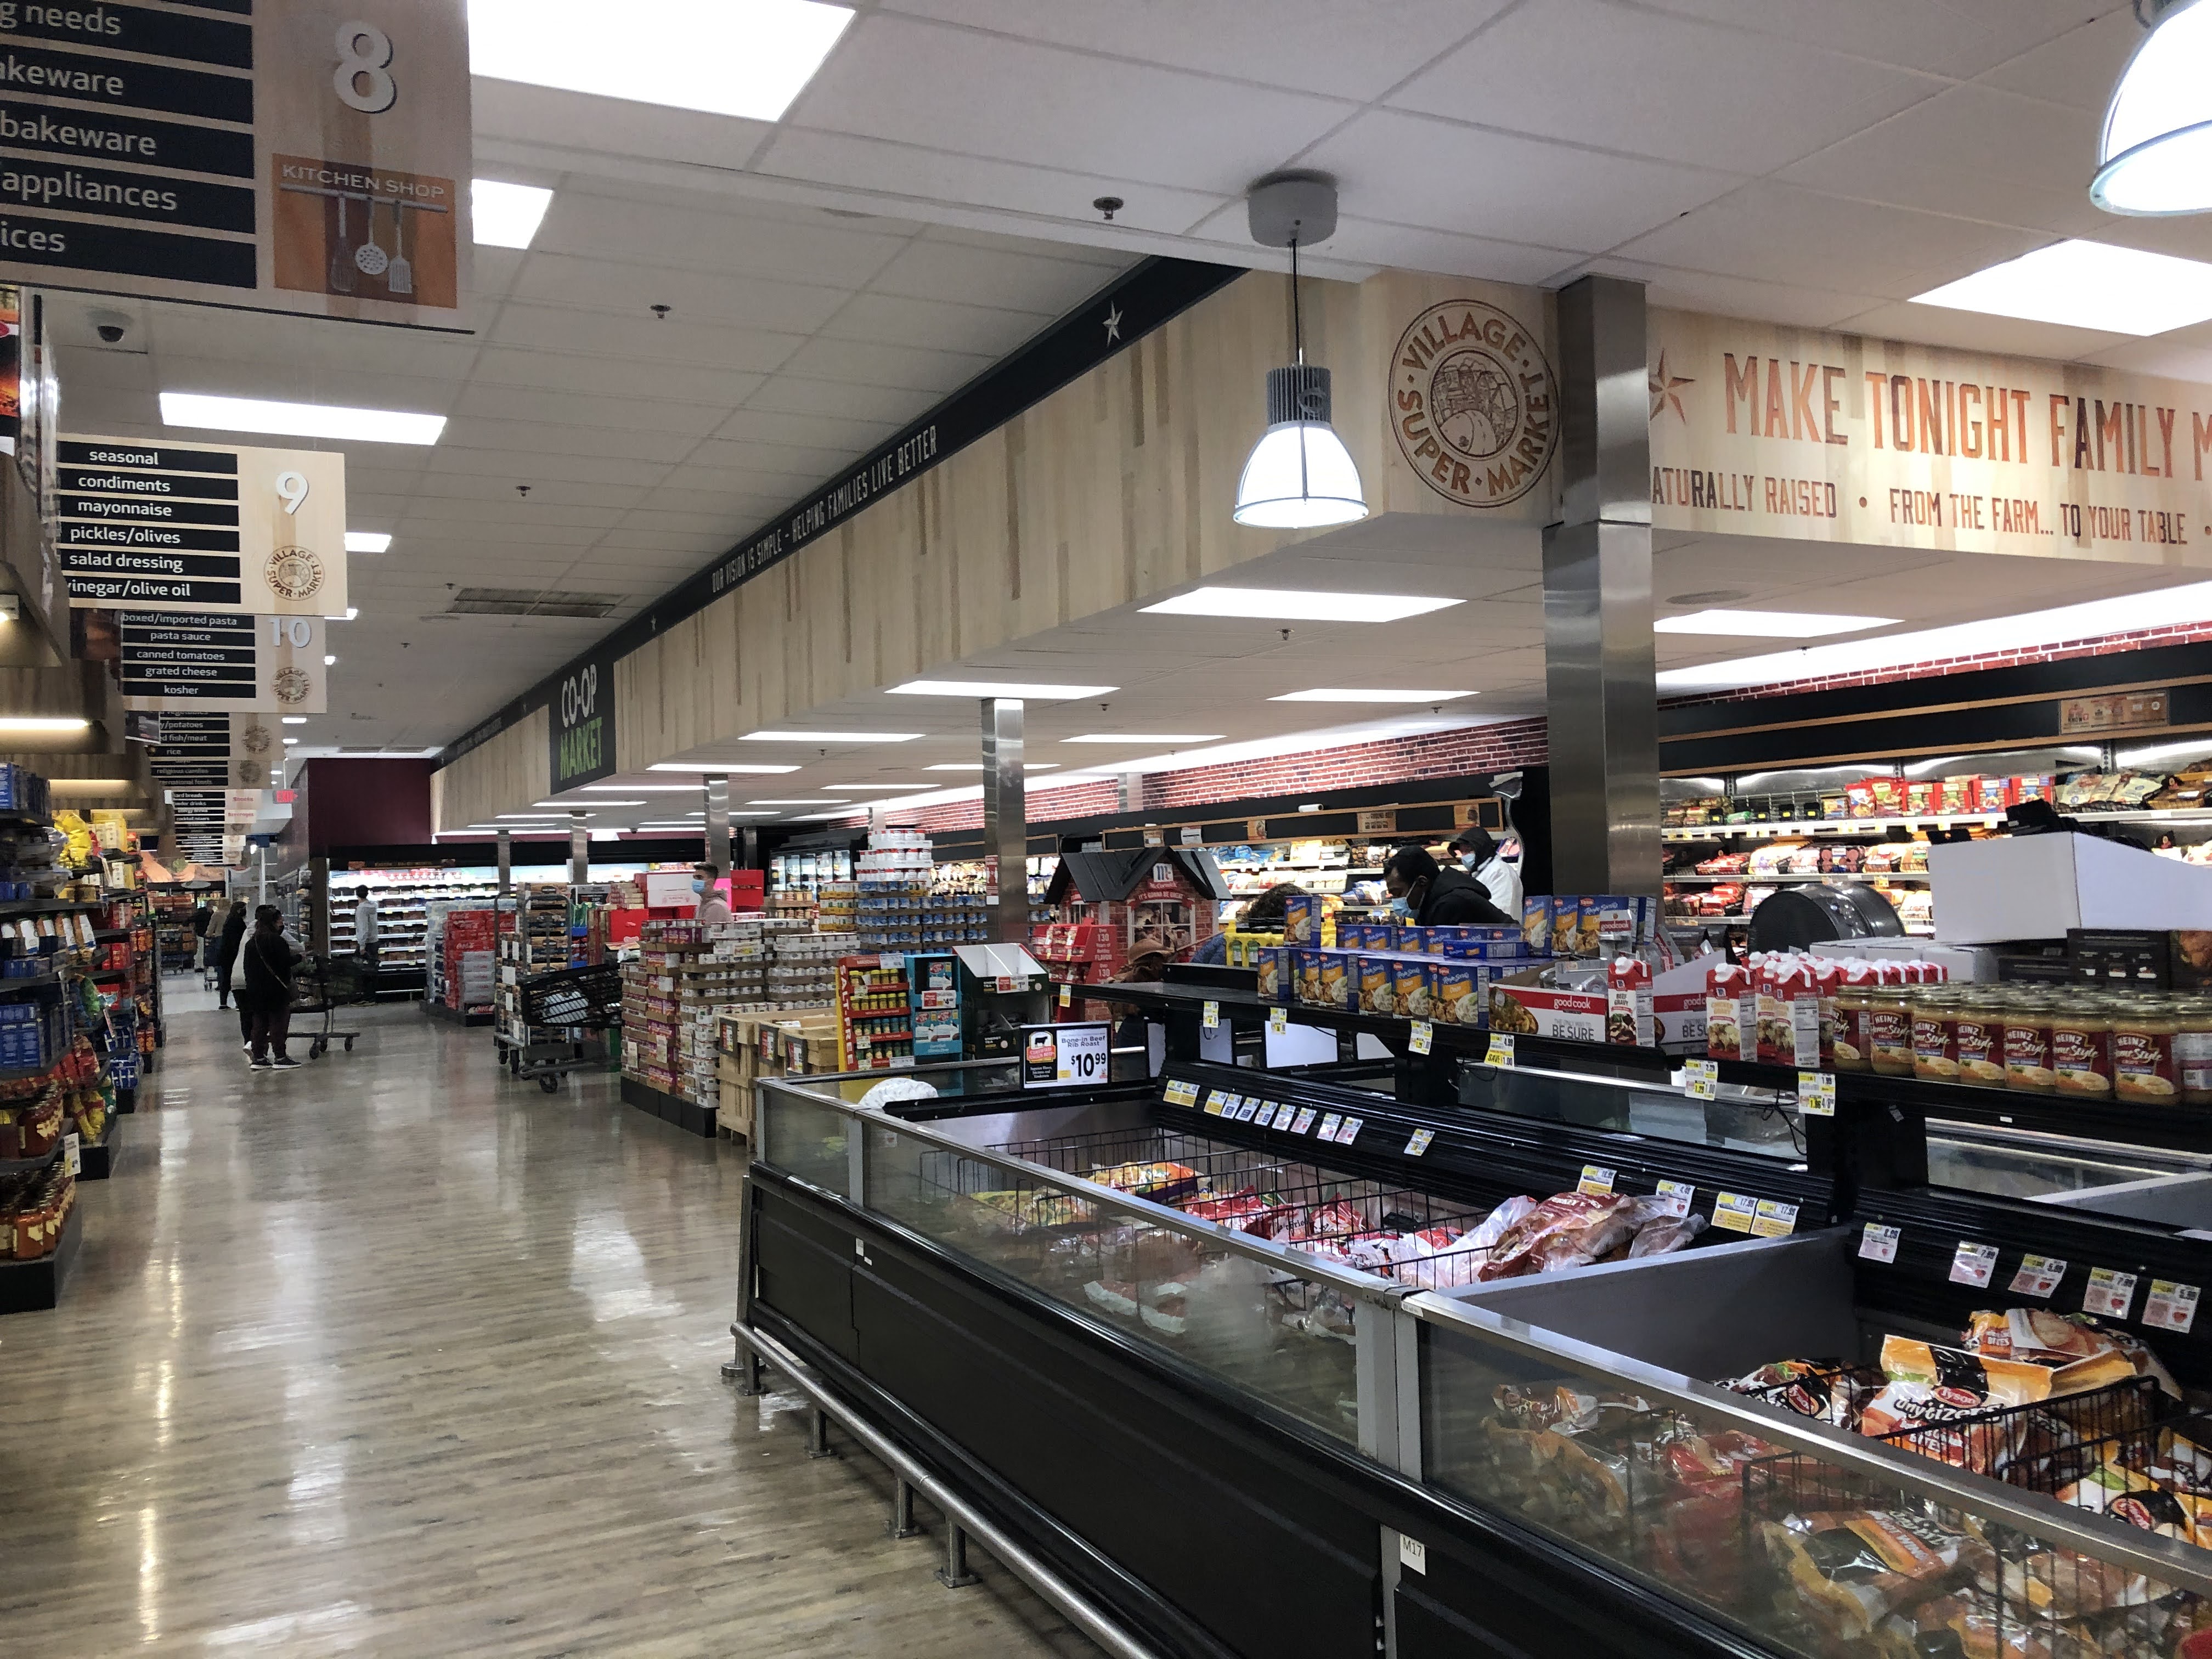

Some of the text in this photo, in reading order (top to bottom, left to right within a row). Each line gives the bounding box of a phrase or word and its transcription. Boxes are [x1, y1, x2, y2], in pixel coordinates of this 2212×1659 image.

[26, 5, 122, 35] needs
[334, 20, 397, 114] 8
[1, 109, 157, 155] bakeware
[283, 163, 445, 199] KITCHEN SHOP
[2, 171, 178, 211] appliances
[1402, 311, 1527, 370] VILLAGE
[1724, 352, 1848, 446] MAKE
[1865, 371, 2030, 464] TONIGHT
[2049, 394, 2176, 479] FAMILY
[1397, 390, 1471, 494] SUPER
[1487, 372, 1550, 497] MARKET
[89, 448, 159, 466] seasonal
[78, 475, 171, 493] condiments
[276, 471, 309, 515] 9
[77, 500, 173, 517] mayonnaise
[726, 553, 746, 585] VISION
[748, 548, 755, 571] IS
[757, 529, 782, 565] SIMPLE
[792, 501, 825, 543] HELPING
[828, 471, 868, 520] FAMILIES
[872, 454, 894, 493] LIVE
[898, 425, 937, 476] BETTER
[1652, 466, 1754, 511] ATURALLY
[1765, 476, 1837, 518] RAISED
[1889, 488, 1942, 527] FROM
[1949, 494, 1985, 530] THE
[2061, 503, 2082, 538] TO
[2088, 505, 2132, 541] YOUR
[2138, 510, 2188, 545] TABLE
[70, 527, 181, 545] pickles/olives
[69, 552, 183, 574] salad dressing
[269, 549, 313, 566] VILLAGE
[174, 583, 191, 596] oil
[267, 569, 292, 597] SUPER
[297, 563, 322, 599] MARKET
[121, 613, 238, 627] boxed/imported pasta
[150, 631, 211, 642] pasta sauce
[268, 617, 311, 647] 10
[136, 650, 225, 661] canned tomatoes
[145, 667, 218, 678] grated cheese
[163, 685, 199, 695] kosher
[561, 663, 597, 728] CO-OP
[560, 716, 602, 781] MARKET
[1097, 933, 1110, 942] 130
[1098, 968, 1110, 977] 130
[1683, 994, 1706, 1010] goodc
[840, 964, 854, 1065] SALT-FREE
[1875, 1014, 1899, 1025] HEINZ
[1552, 1024, 1595, 1042] BE SURE
[1682, 1024, 1696, 1038] BE
[1915, 1023, 1936, 1032] HEINZ
[2007, 1030, 2034, 1041] HEINZ
[2056, 1034, 2083, 1045] HEINZ
[2117, 1036, 2147, 1048] HEINZ
[1487, 1053, 1500, 1064] SAVE
[1941, 1387, 1975, 1404] Tyson
[1403, 1536, 1422, 1558] M17
